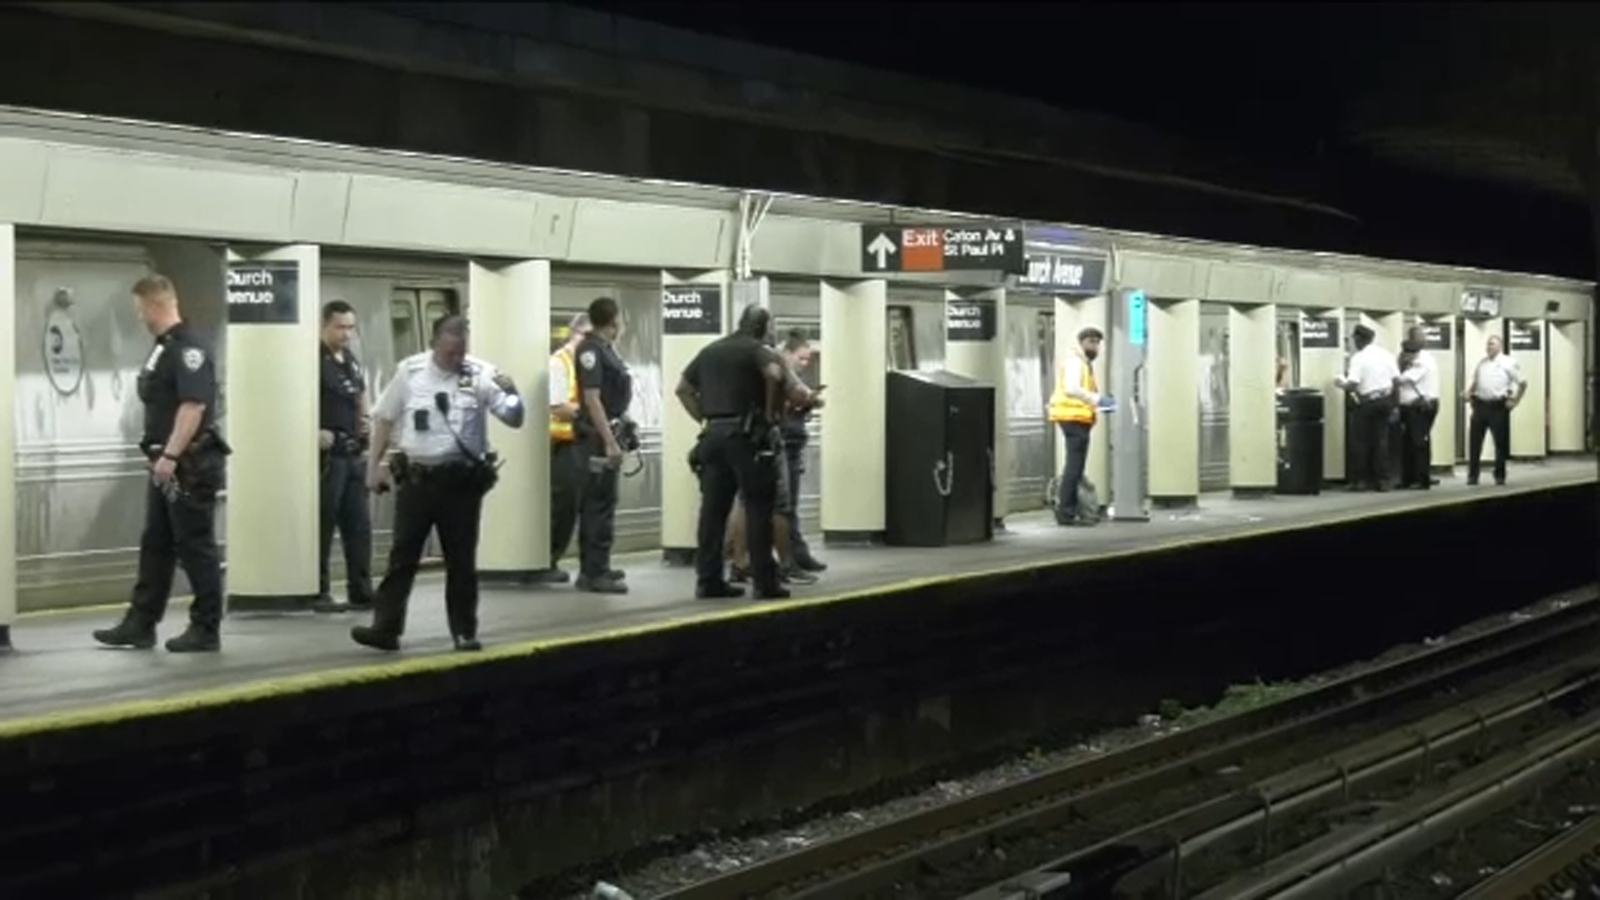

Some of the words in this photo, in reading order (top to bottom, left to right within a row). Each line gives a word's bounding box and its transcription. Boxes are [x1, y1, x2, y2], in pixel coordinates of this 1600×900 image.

[902, 229, 939, 246] Exit
[985, 229, 1000, 241] Av
[1005, 229, 1015, 241] &
[962, 244, 989, 256] Paul
